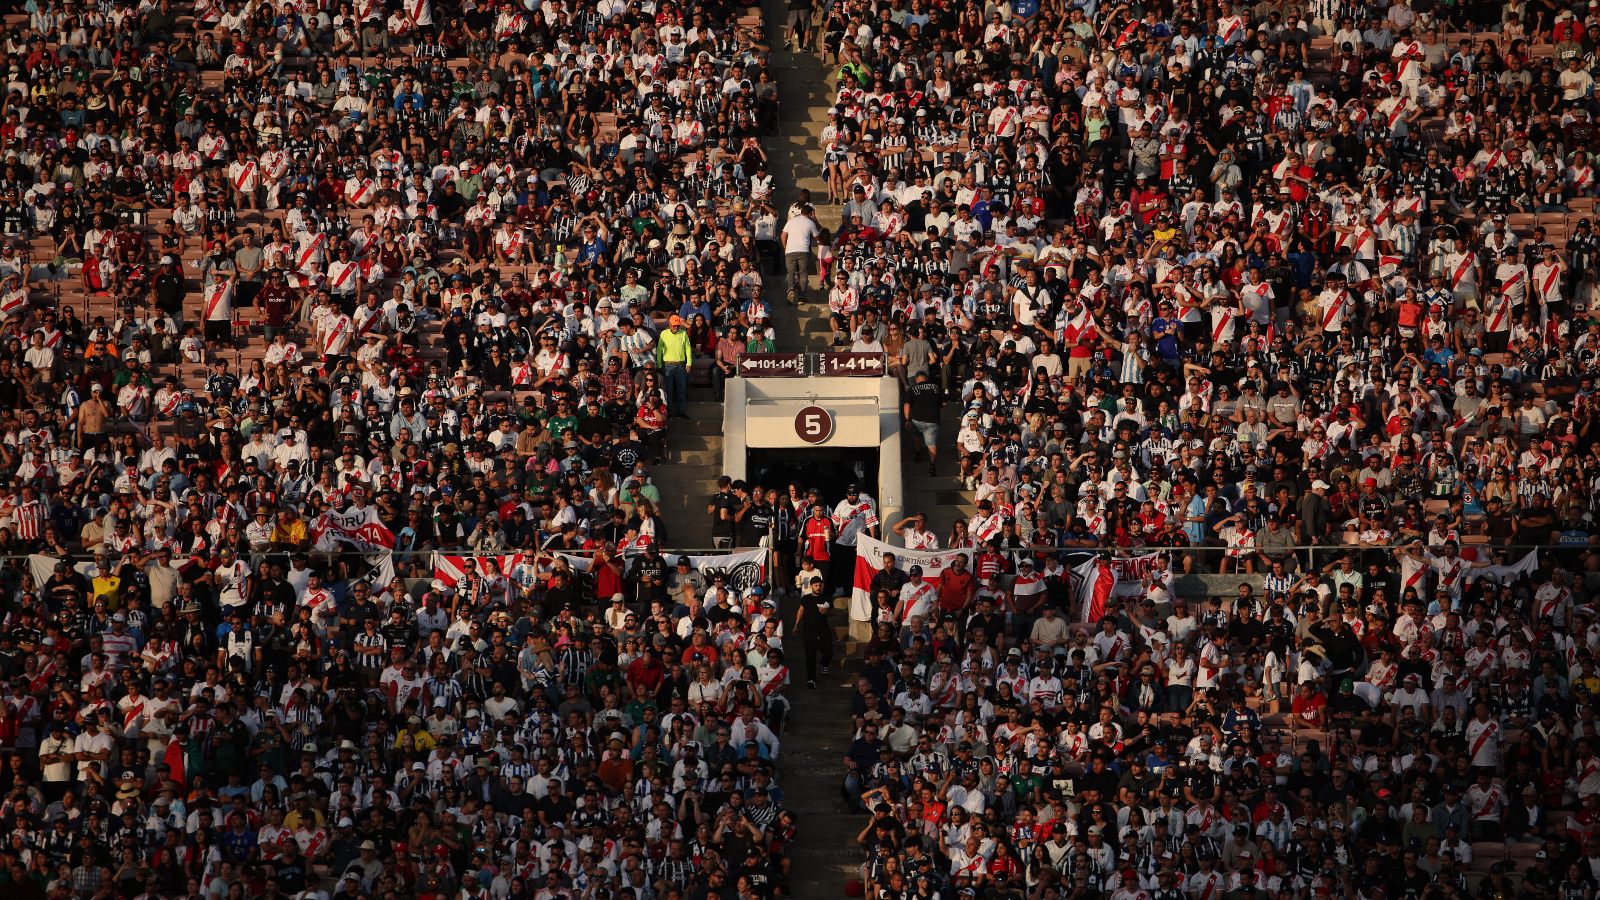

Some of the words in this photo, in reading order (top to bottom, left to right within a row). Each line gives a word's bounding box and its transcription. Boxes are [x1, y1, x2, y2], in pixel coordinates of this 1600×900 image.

[757, 359, 798, 369] 101-141
[830, 358, 866, 370] 1-41
[805, 414, 821, 435] 5
[64, 519, 72, 527] 10
[331, 511, 366, 527] PIRU
[897, 555, 930, 566] CORTIÑAS
[525, 576, 533, 584] 10
